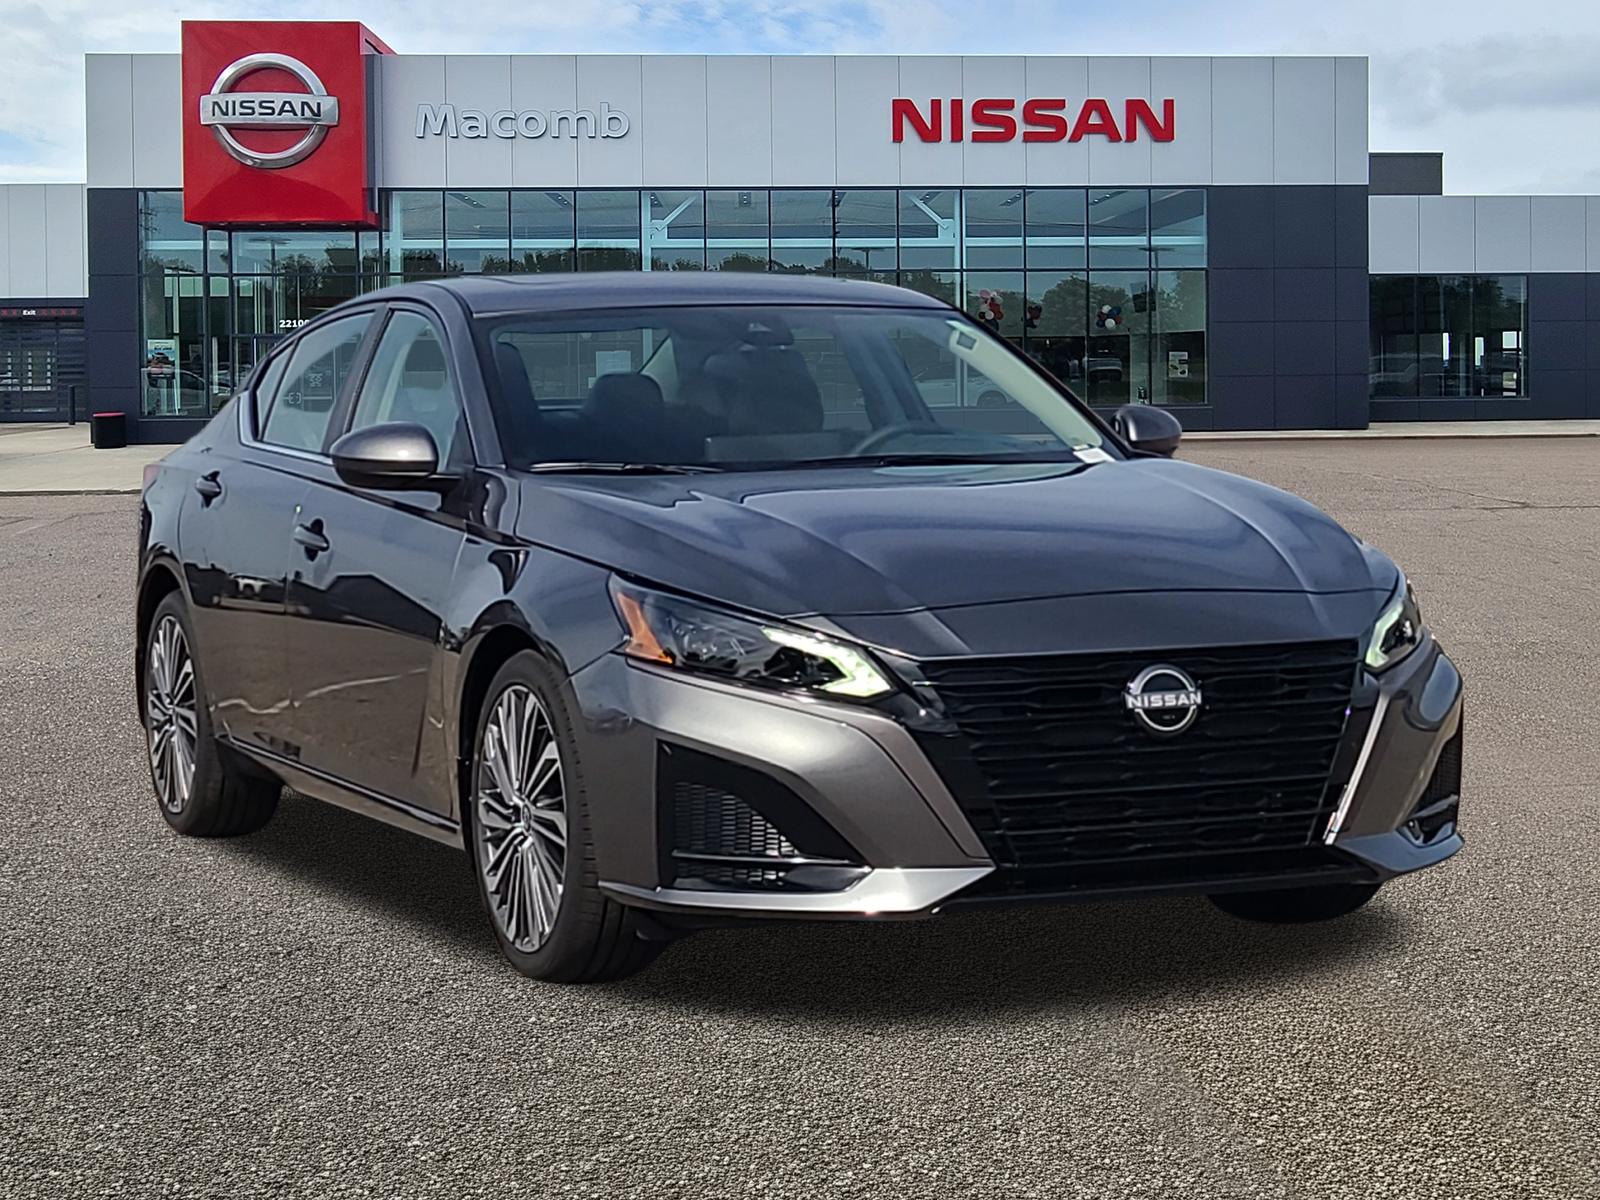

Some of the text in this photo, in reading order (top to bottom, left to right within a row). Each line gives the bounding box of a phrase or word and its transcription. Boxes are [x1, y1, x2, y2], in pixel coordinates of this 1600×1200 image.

[211, 99, 322, 118] NISSAN
[415, 101, 630, 139] Macomb
[891, 98, 1175, 143] NISSAN
[1125, 691, 1202, 709] NISSAN
